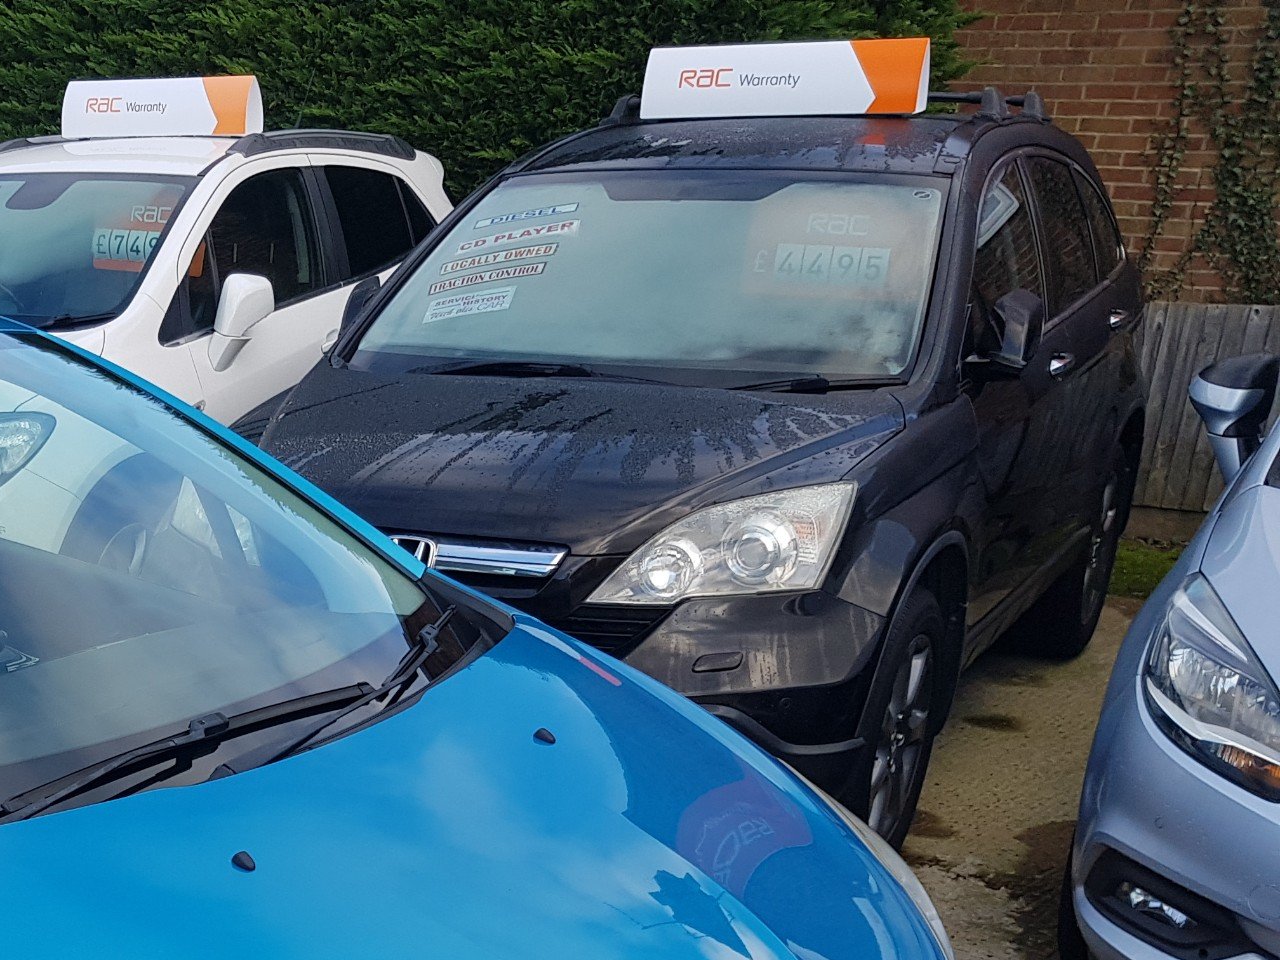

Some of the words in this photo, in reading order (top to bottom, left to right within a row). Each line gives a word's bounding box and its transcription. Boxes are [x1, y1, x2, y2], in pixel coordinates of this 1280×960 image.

[739, 73, 801, 89] Warranty
[125, 101, 168, 115] Warranty
[489, 207, 562, 225] DIESEL
[459, 239, 487, 251] CD
[493, 221, 575, 243] PLAYER
[443, 254, 503, 273] LOCALLY
[504, 245, 553, 260] OWNED
[432, 274, 486, 293] TRACTION
[488, 265, 541, 280] CONTROL
[462, 294, 508, 307] HISTORY
